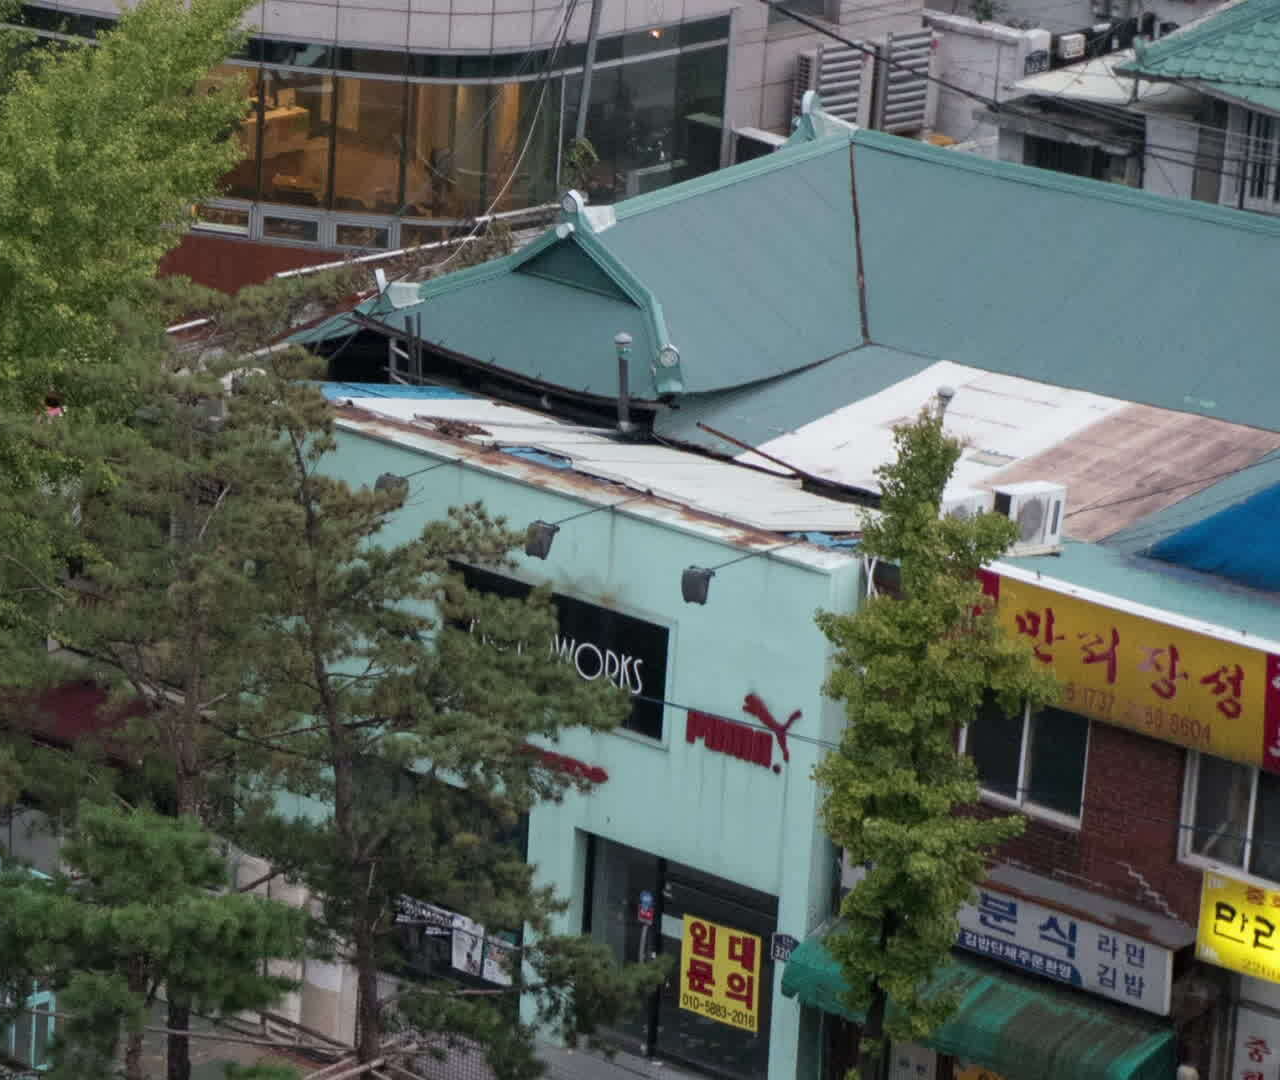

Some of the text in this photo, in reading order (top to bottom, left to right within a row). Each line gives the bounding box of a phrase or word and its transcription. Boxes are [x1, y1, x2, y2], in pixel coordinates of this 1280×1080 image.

[689, 921, 756, 973] 임대
[978, 891, 1077, 960] 분식
[1098, 933, 1145, 968] 라면
[687, 957, 755, 1012] 문의
[1097, 963, 1145, 1000] 김밥
